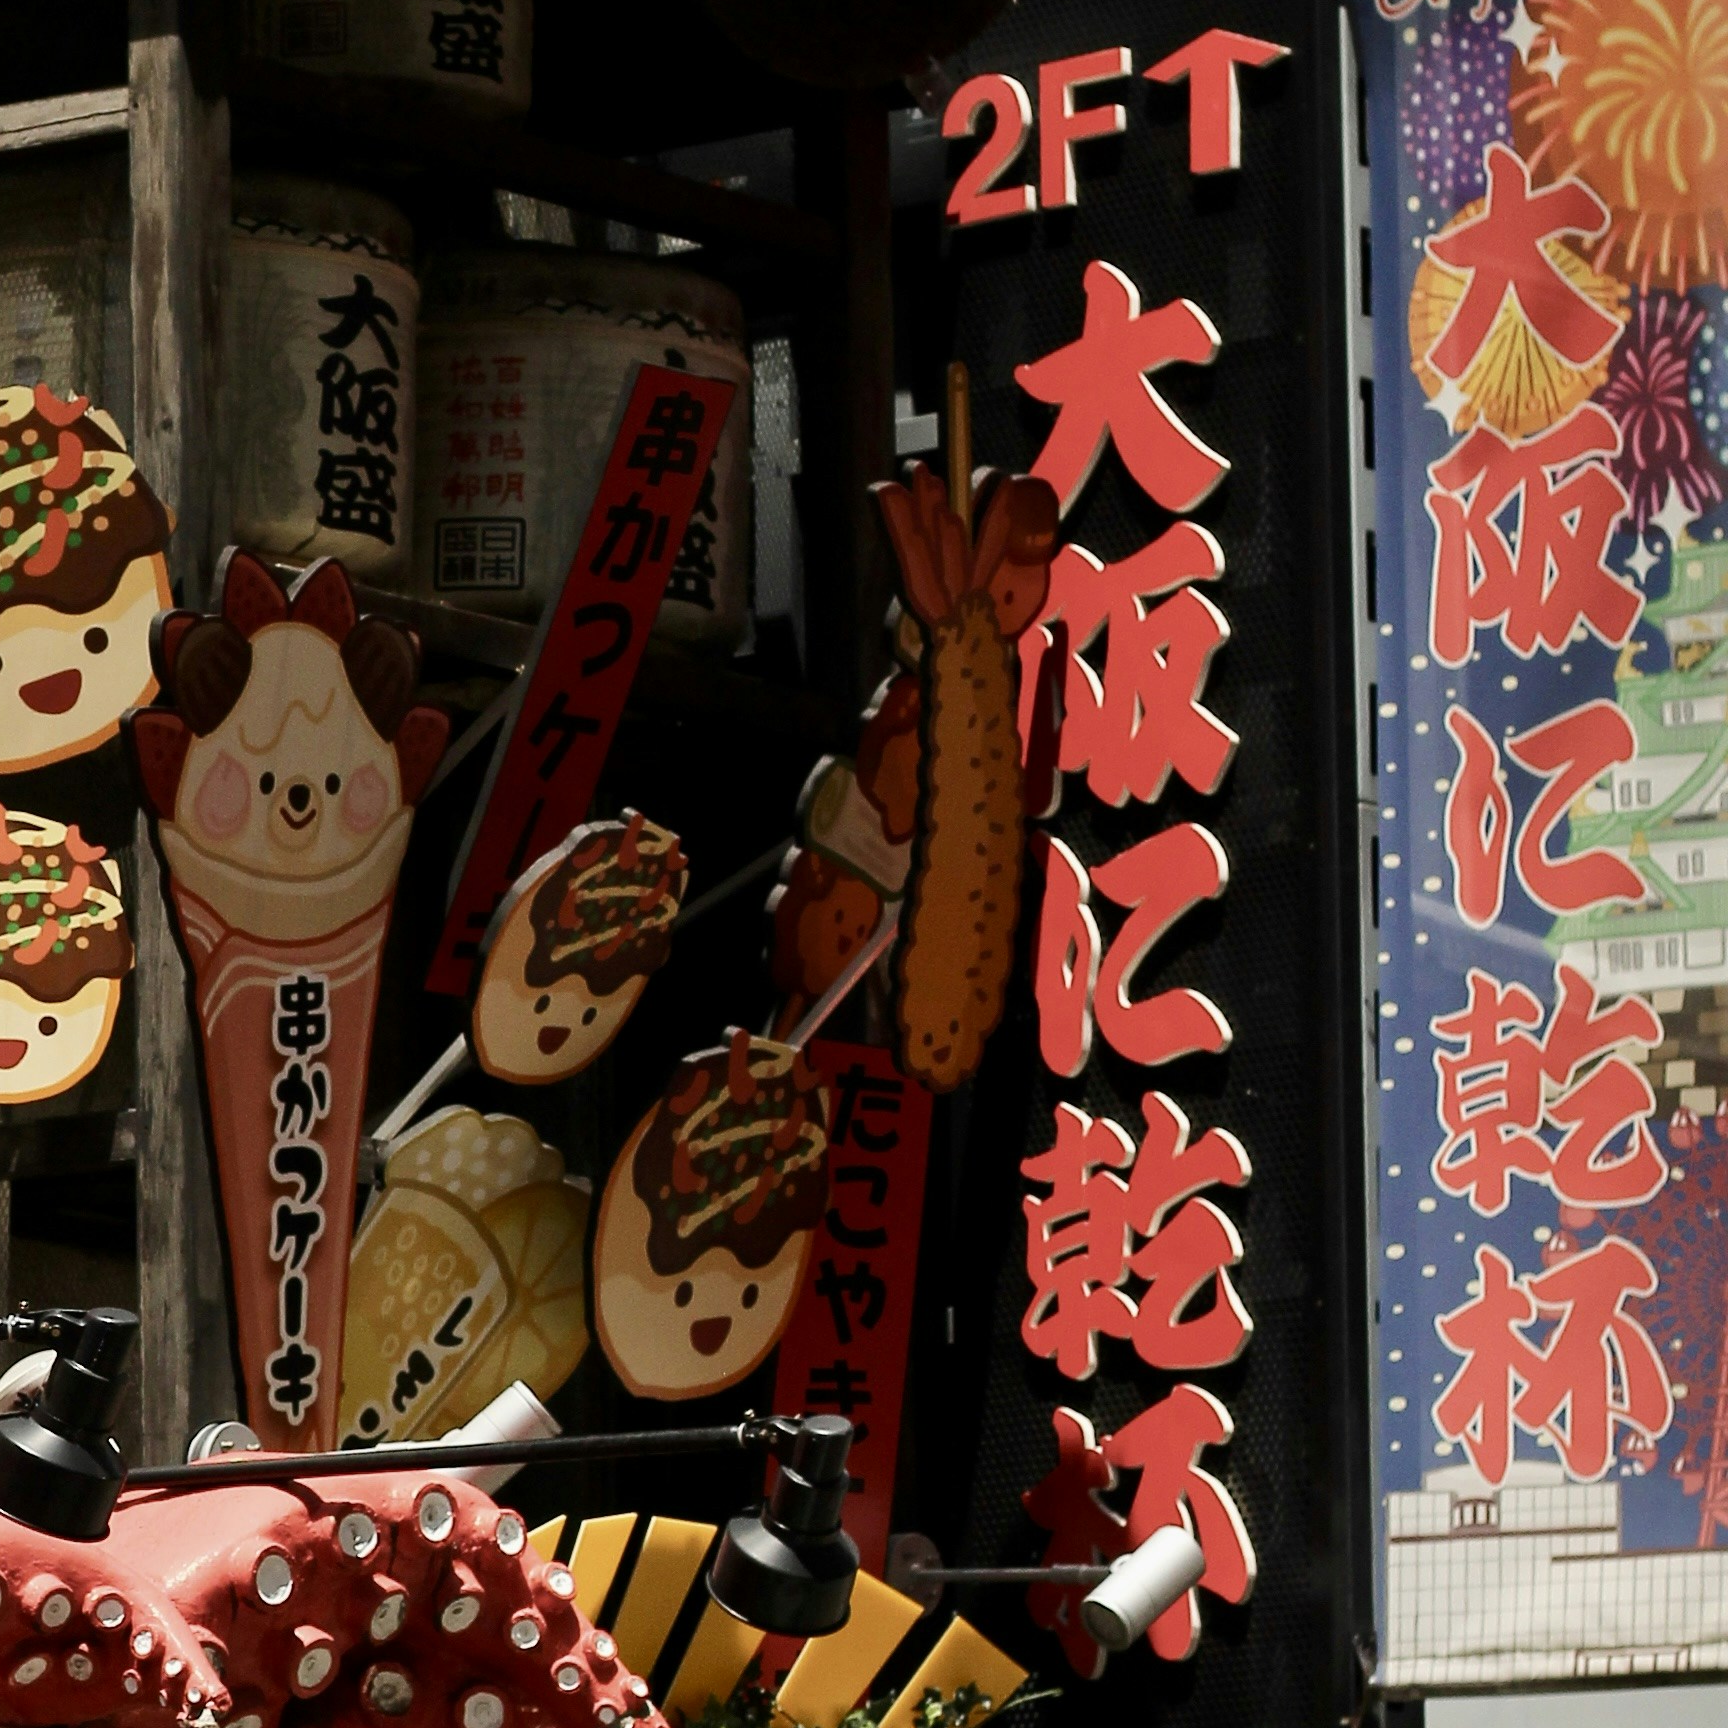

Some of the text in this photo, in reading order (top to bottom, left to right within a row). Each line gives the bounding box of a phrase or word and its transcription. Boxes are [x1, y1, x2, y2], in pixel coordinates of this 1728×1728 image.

[941, 47, 1132, 227] 2F
[314, 273, 400, 546] 大阪盛
[1015, 257, 1257, 1680] 大阪に乾杯
[1425, 142, 1675, 1485] 大阪に乾杯
[266, 973, 335, 1426] 串かつケーキ
